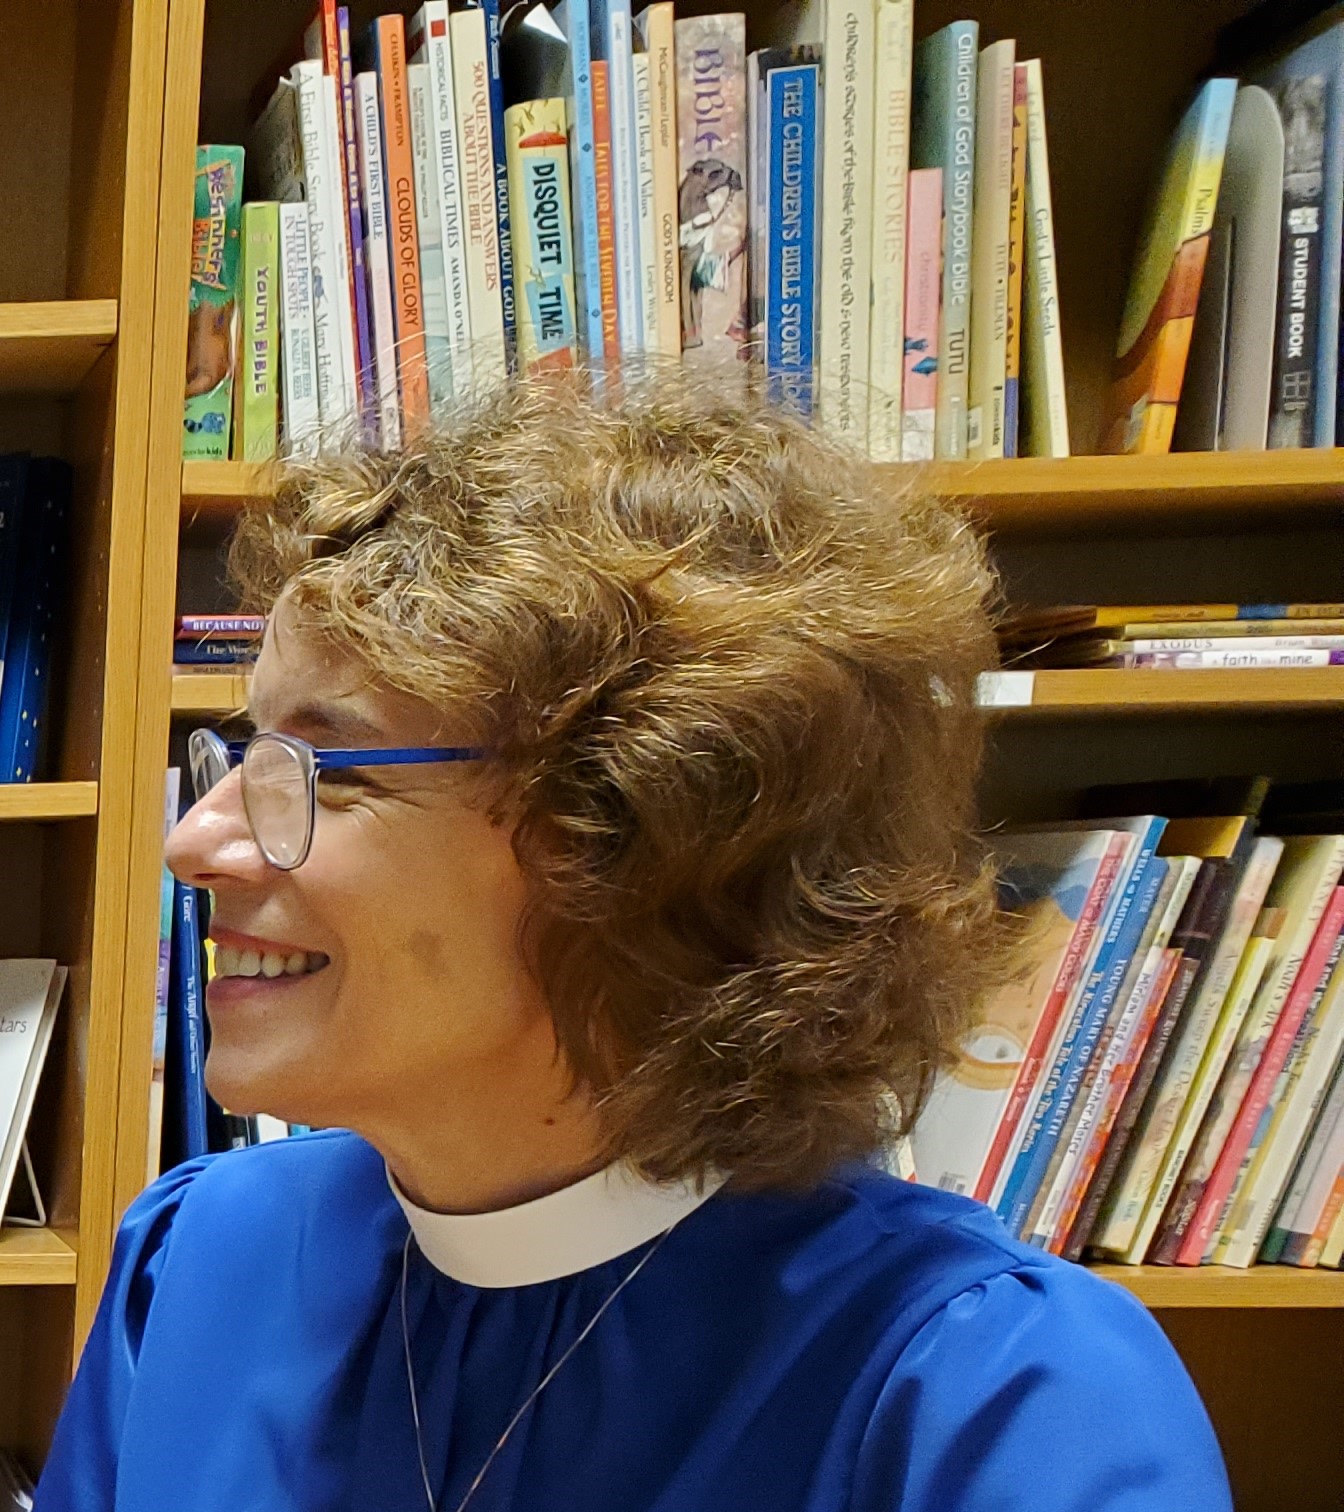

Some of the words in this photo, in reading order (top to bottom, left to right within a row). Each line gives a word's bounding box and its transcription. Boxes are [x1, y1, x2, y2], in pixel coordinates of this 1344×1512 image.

[955, 33, 974, 108] Children
[693, 48, 725, 153] BIBLE
[955, 111, 971, 123] of
[955, 127, 972, 165] God
[395, 177, 412, 244] CLOUDS
[532, 161, 562, 265] DISQUIET
[951, 170, 971, 257] Storybook
[399, 251, 414, 269] OF
[951, 263, 970, 305] Bible
[1290, 237, 1306, 309] STUDENT
[254, 267, 269, 332] YOUTH
[402, 274, 418, 326] GLORY
[538, 286, 563, 341] TIME
[948, 328, 965, 374] TUTU
[1288, 313, 1305, 358] BOOK
[253, 339, 269, 395] BIBLE
